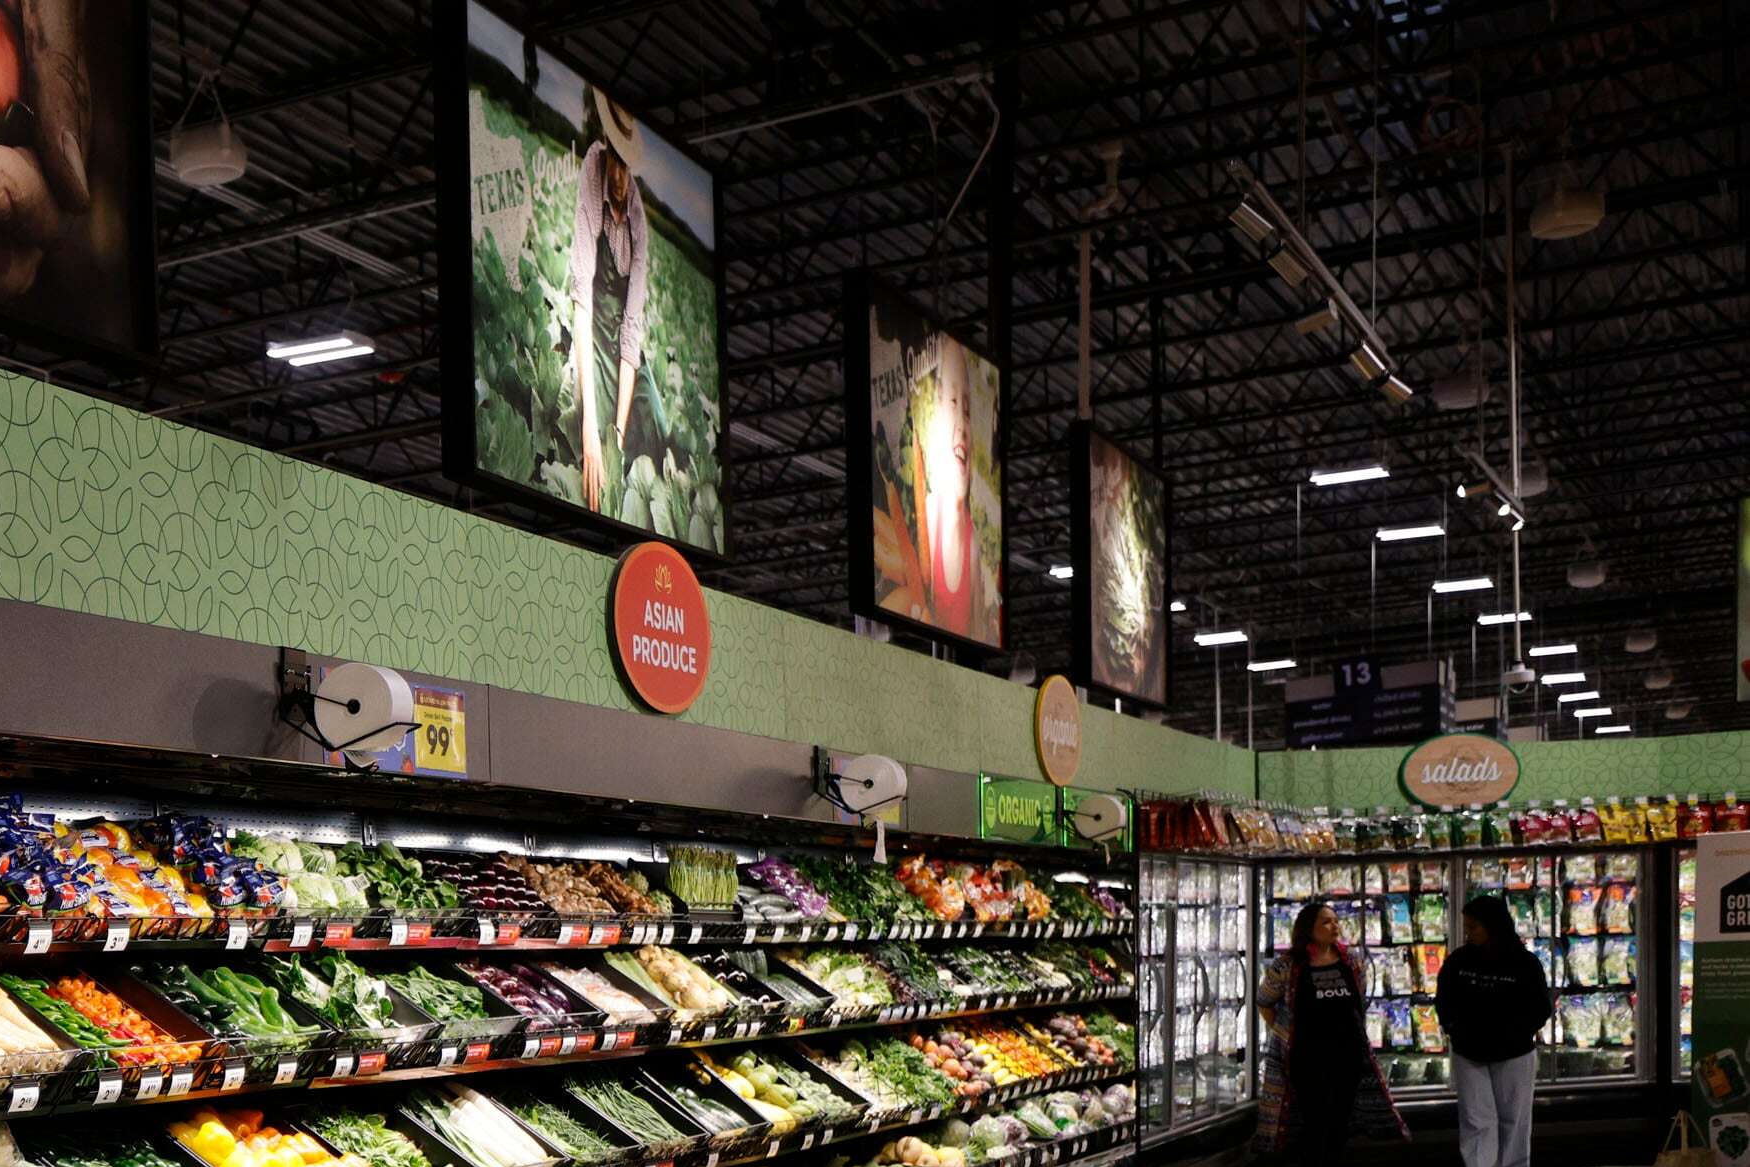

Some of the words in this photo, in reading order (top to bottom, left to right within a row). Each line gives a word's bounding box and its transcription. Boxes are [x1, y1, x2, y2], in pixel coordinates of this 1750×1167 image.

[474, 167, 525, 215] TEXAS
[644, 599, 684, 635] ASIAN
[633, 634, 697, 674] PRODUCE
[1341, 662, 1371, 687] 13
[1421, 753, 1502, 784] salads
[998, 793, 1042, 828] ORGANIC
[1316, 988, 1352, 1000] SOUL
